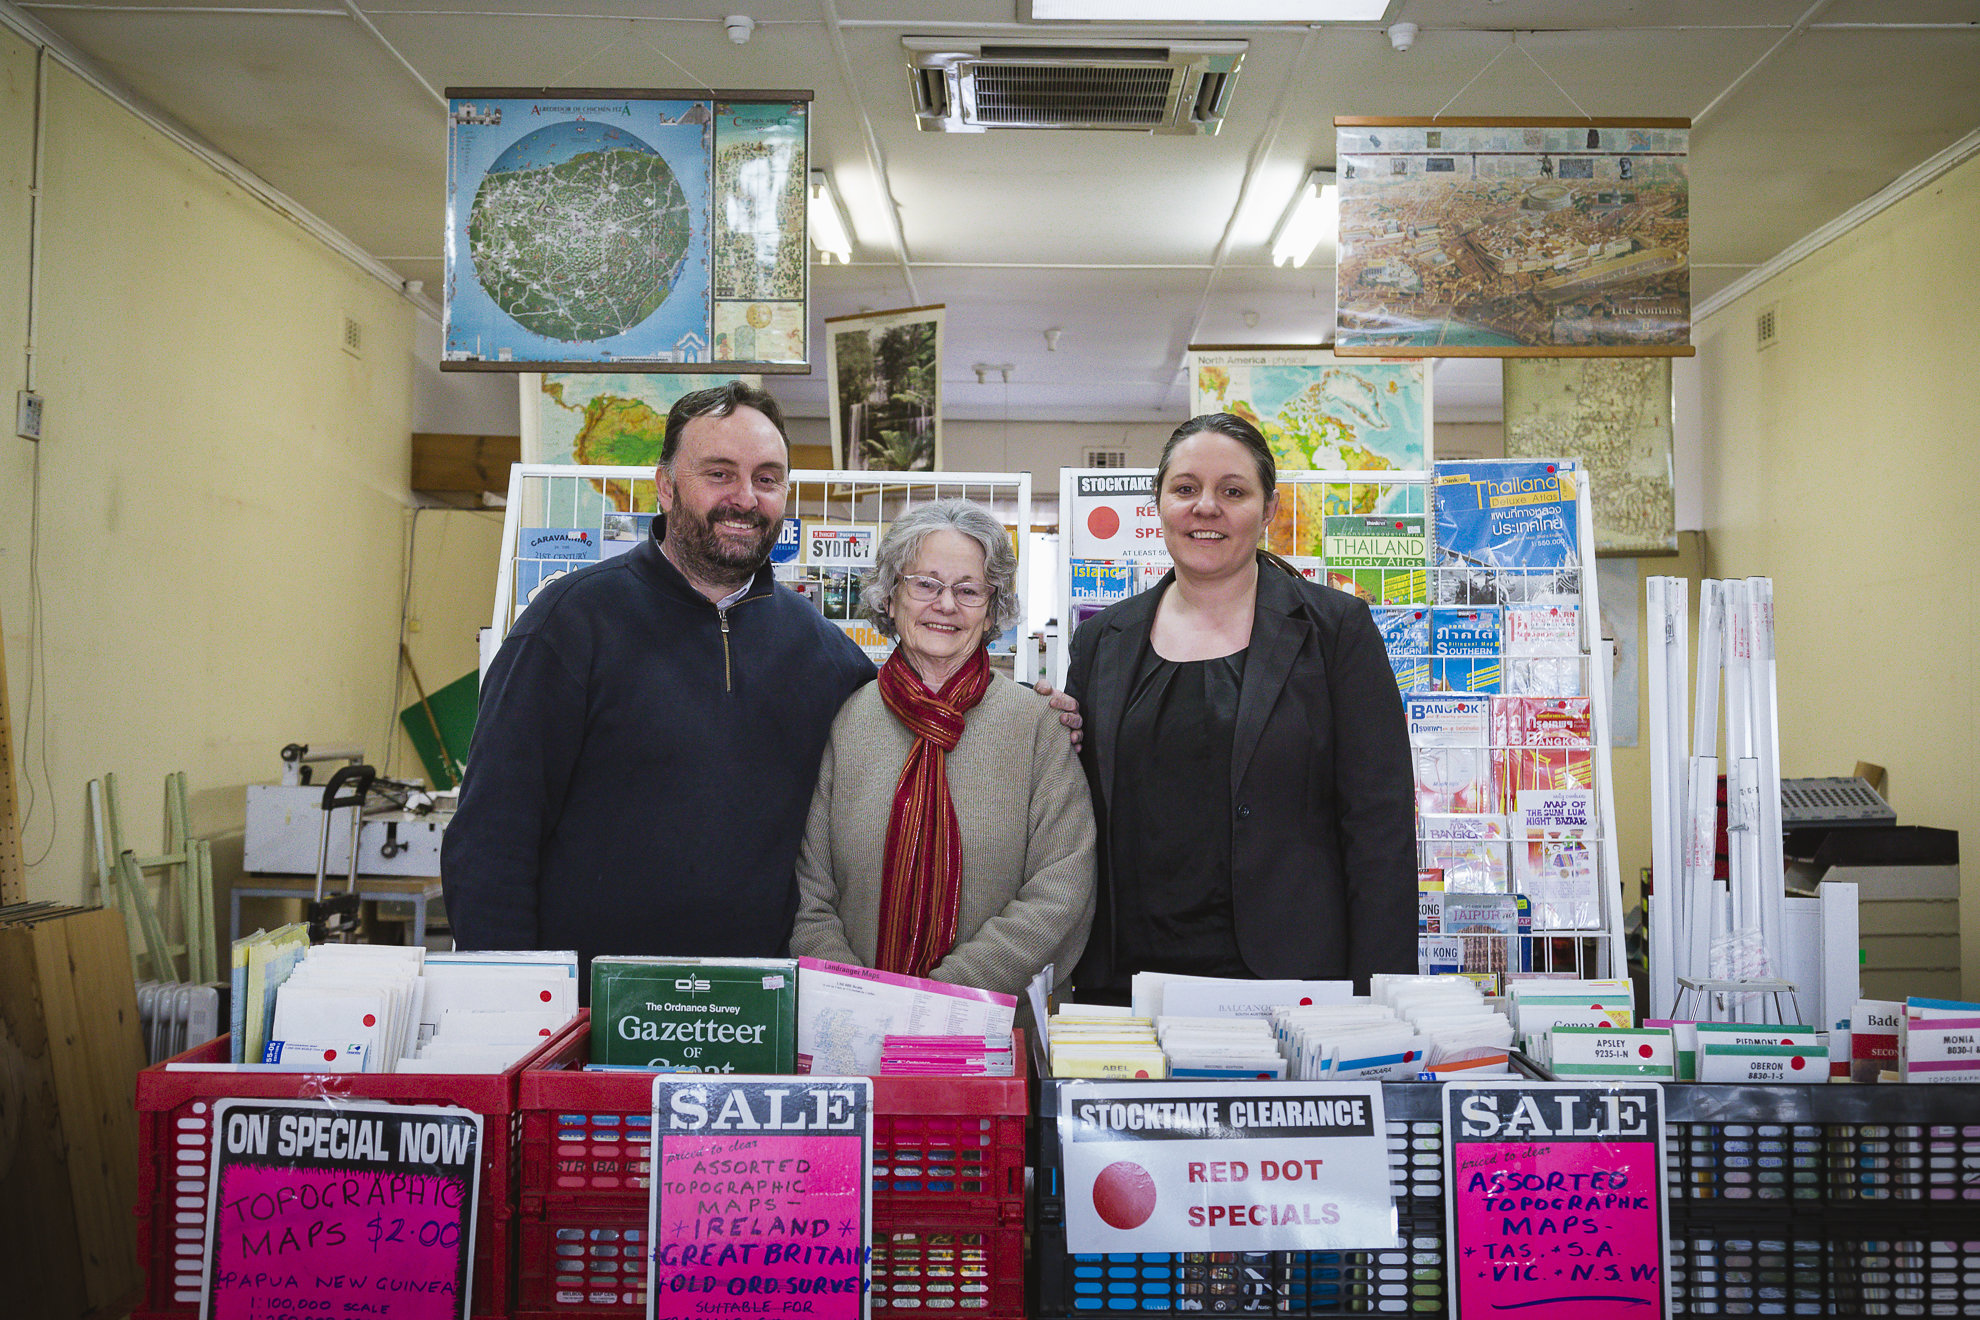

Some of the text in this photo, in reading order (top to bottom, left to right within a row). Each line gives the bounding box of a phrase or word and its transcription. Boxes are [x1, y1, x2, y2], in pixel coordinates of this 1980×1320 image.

[1612, 303, 1682, 315] The Romans
[1198, 356, 1307, 366] North America physical
[1082, 477, 1152, 492] STOCKTAKE
[1470, 473, 1559, 510] Thailand
[1492, 493, 1558, 507] Deluxe Atlas
[1136, 507, 1160, 517] RE
[1135, 528, 1163, 539] SPE
[1333, 538, 1424, 556] THAILAND
[554, 551, 587, 559] CENTURY
[1333, 557, 1422, 567] Handy Atlas
[1074, 587, 1126, 598] Thaland
[1436, 642, 1493, 655] SOUTHERN
[1411, 704, 1479, 719] BANGKOK
[1526, 731, 1588, 746] BANGKOK
[1543, 801, 1567, 809] MAP
[1526, 817, 1587, 825] NIGHT BAZAAR
[1453, 910, 1500, 921] JAIPUR
[1433, 947, 1457, 957] KONG
[824, 962, 880, 979] Landranger Maps
[645, 1002, 740, 1015] The Ordnance Survey
[1868, 1015, 1899, 1027] Bade
[618, 1015, 766, 1044] Gazetteer
[1597, 1040, 1625, 1048] APSLEY
[1943, 1036, 1975, 1044] MONIA
[265, 1042, 276, 1064] 55-05
[683, 1047, 703, 1058] OF
[1871, 1048, 1899, 1056] SECON
[1750, 1062, 1783, 1071] OBERON
[669, 1089, 855, 1131] SALE
[1079, 1099, 1366, 1131] STOCKTAKE CLEARANCE
[1460, 1096, 1648, 1137] SALE
[227, 1113, 471, 1165] ON SPECIAL NOW
[666, 1139, 758, 1165] priced to clear
[1460, 1146, 1551, 1172] priced to clear
[556, 1160, 637, 1173] STRBAE
[693, 1158, 811, 1175] ASSORTED
[1735, 1157, 1783, 1167] Catogue
[1188, 1159, 1323, 1183] RED DOT
[664, 1180, 806, 1195] TOPOGRAPHIC
[1468, 1171, 1629, 1194] ASSORTED
[226, 1177, 466, 1222] TOPOGRAPHIC
[1482, 1194, 1649, 1212] TOPOGRAPHIC
[1188, 1202, 1341, 1228] SPECIALS
[695, 1215, 830, 1240] IRELAND
[241, 1220, 346, 1258] MAPS
[660, 1243, 872, 1267] GREAT BRITAIN
[315, 1275, 368, 1289] NEW
[376, 1277, 455, 1295] GUINEA
[669, 1274, 871, 1296] OLD ORD. SURVEY
[343, 1302, 390, 1314] SCALE
[695, 1301, 814, 1314] SUITABLE FOR
